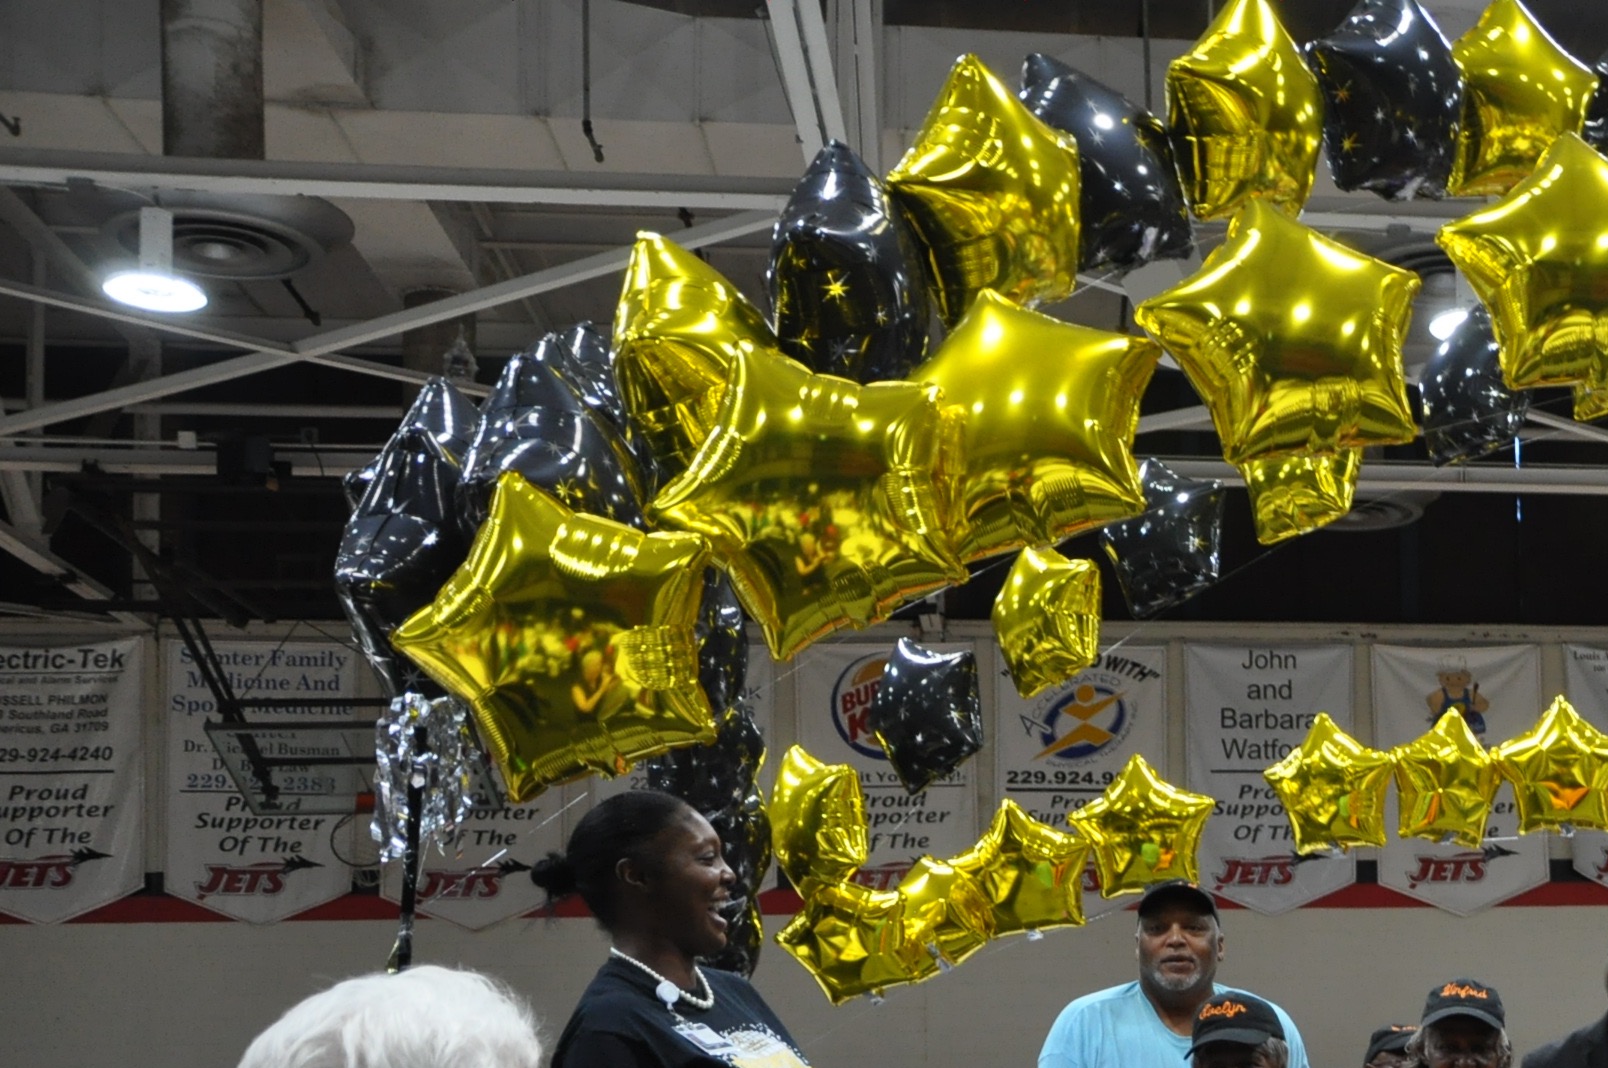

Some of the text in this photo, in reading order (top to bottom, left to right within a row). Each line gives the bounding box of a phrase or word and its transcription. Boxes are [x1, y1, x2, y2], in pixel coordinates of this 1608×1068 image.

[270, 649, 348, 671] Family
[1241, 650, 1298, 670] John
[296, 674, 341, 692] And
[1246, 679, 1293, 701] and
[278, 743, 341, 756] Busman
[8, 784, 89, 801] Proud
[194, 812, 326, 833] Supporter
[4, 826, 93, 849] Of The
[473, 830, 517, 846] The
[887, 834, 931, 850] The
[1233, 824, 1263, 844] Of
[218, 836, 303, 856] Of The
[193, 864, 290, 898] JETS
[1212, 859, 1296, 890] JETS
[1406, 855, 1489, 889] JETS
